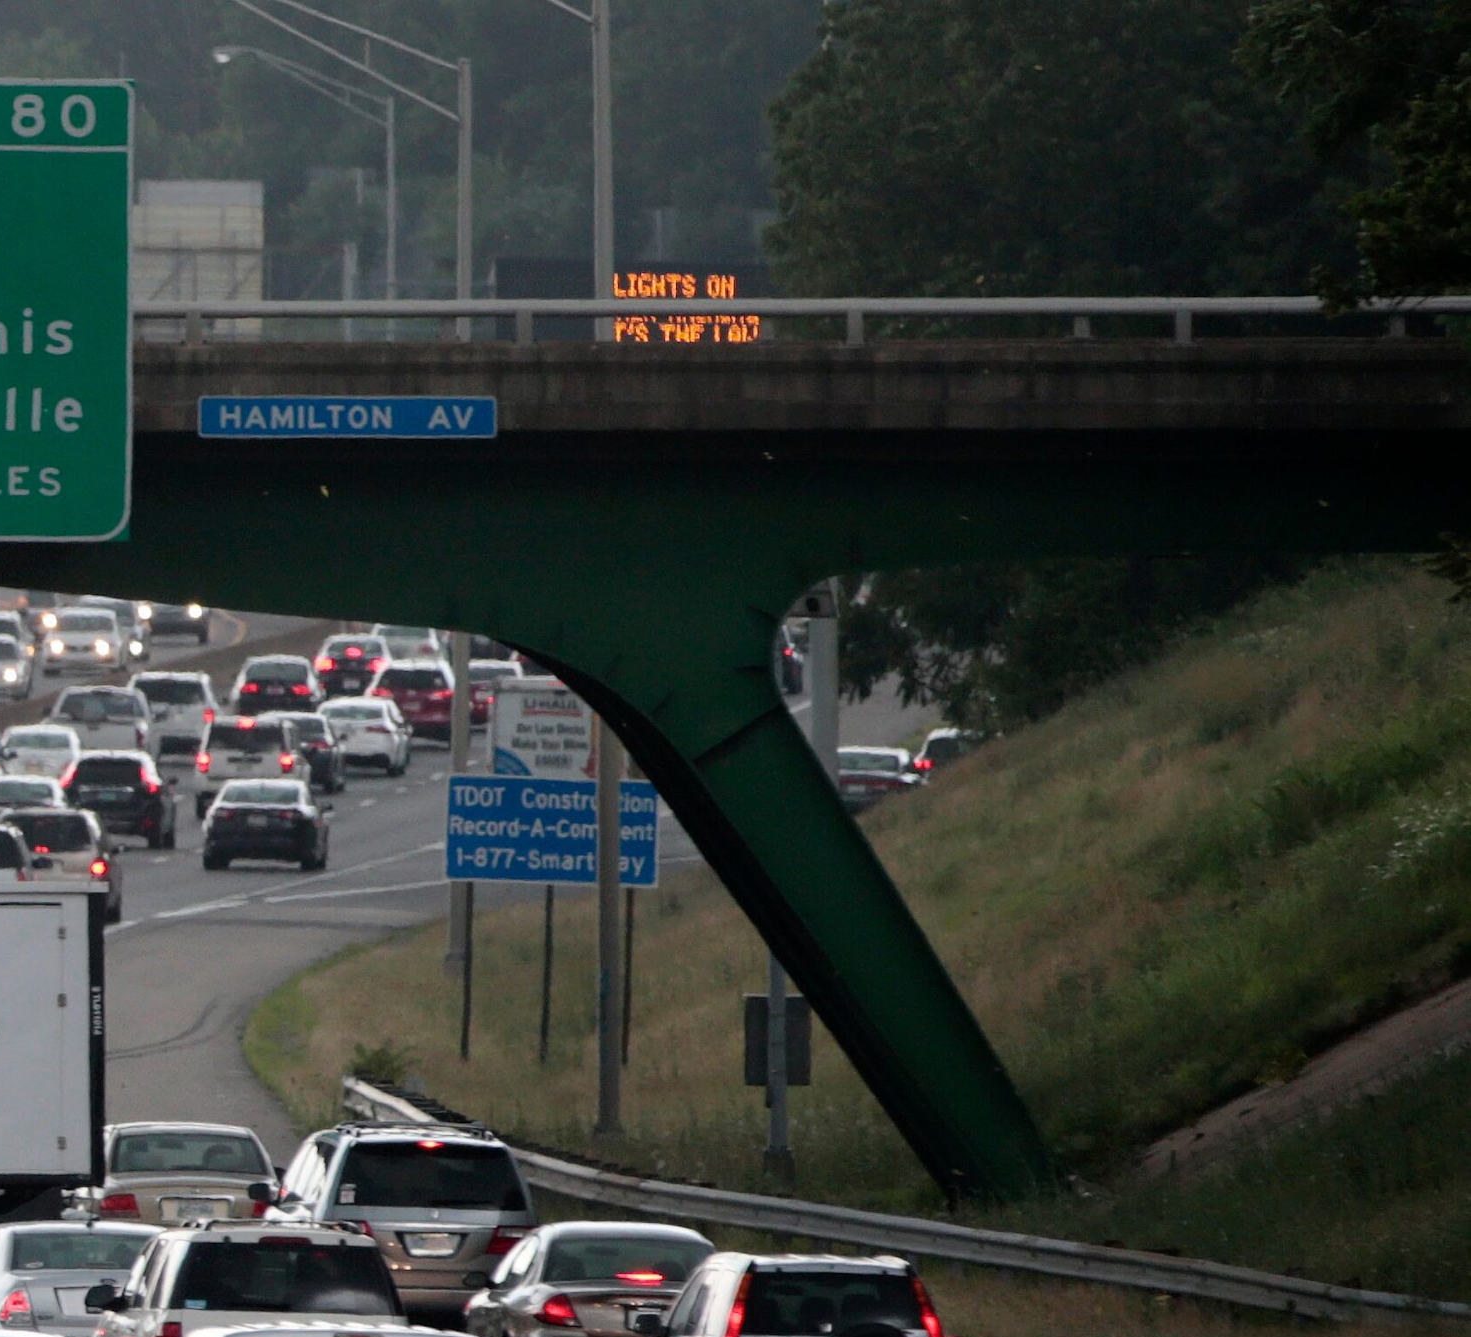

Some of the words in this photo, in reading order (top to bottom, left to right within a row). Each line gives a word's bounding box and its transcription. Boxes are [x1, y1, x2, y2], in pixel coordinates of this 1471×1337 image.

[11, 94, 97, 138] 80
[613, 272, 697, 298] LIGHTS
[707, 274, 736, 299] ON
[219, 404, 393, 430] HAMILTON
[427, 405, 474, 430] AV
[453, 785, 506, 807] TDOT
[521, 788, 654, 812] Constrion
[450, 814, 654, 840] Record-A-Coment
[456, 847, 645, 877] 1-877-Smartay
